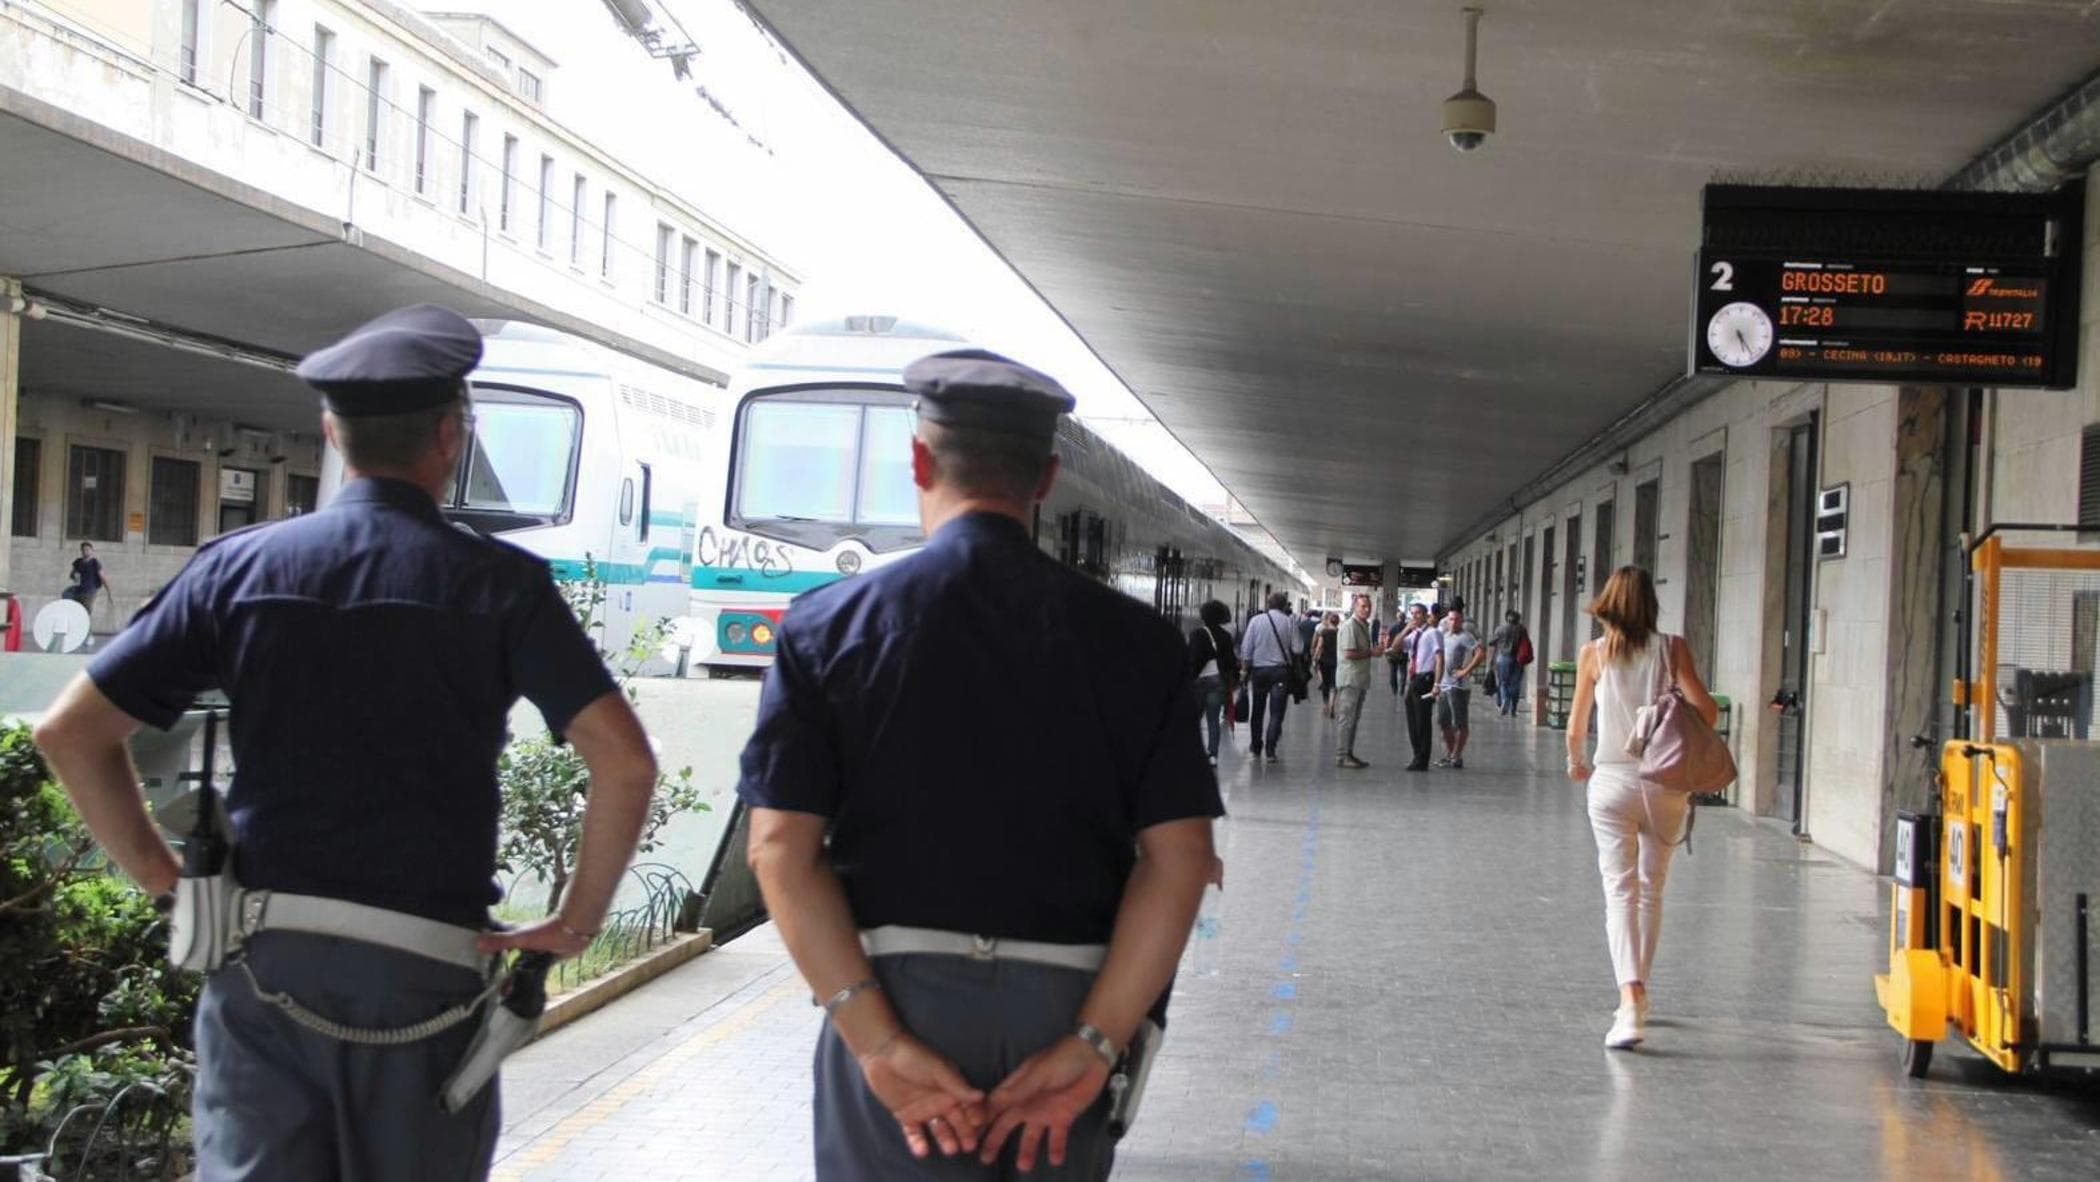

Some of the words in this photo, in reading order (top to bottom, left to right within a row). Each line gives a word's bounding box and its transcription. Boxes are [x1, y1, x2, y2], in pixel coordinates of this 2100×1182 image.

[1710, 261, 1733, 290] 2
[1782, 271, 1884, 294] GROSSETO
[1780, 306, 1834, 326] 17:28
[1965, 311, 1986, 331] R
[1988, 313, 2033, 328] 11727
[1823, 349, 1868, 361] CECINA
[1938, 353, 2016, 366] CASTAGNETO
